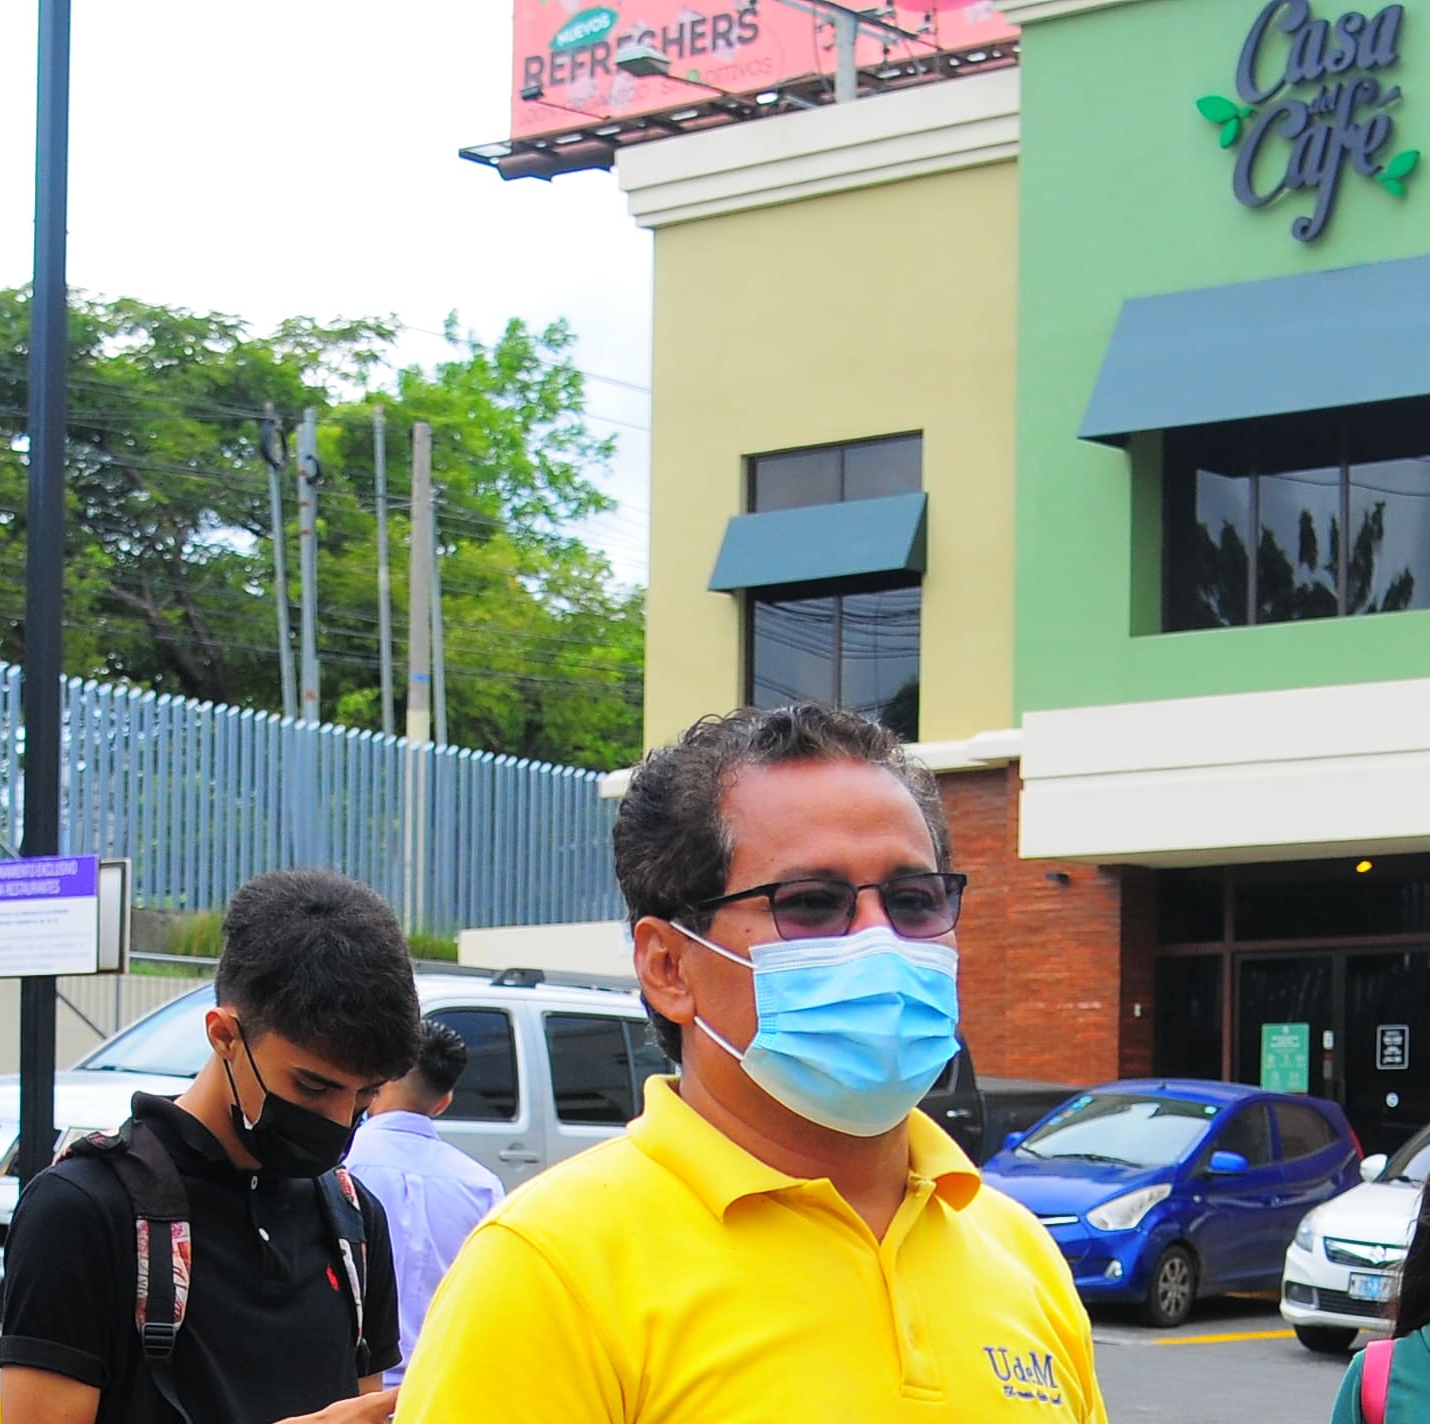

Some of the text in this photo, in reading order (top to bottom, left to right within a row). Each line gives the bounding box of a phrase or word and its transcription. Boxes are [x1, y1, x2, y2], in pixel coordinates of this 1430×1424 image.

[556, 12, 611, 47] NUEVOS
[1235, 0, 1404, 104] Casa
[1233, 76, 1403, 242] Café
[983, 1346, 1059, 1389] UdeM
